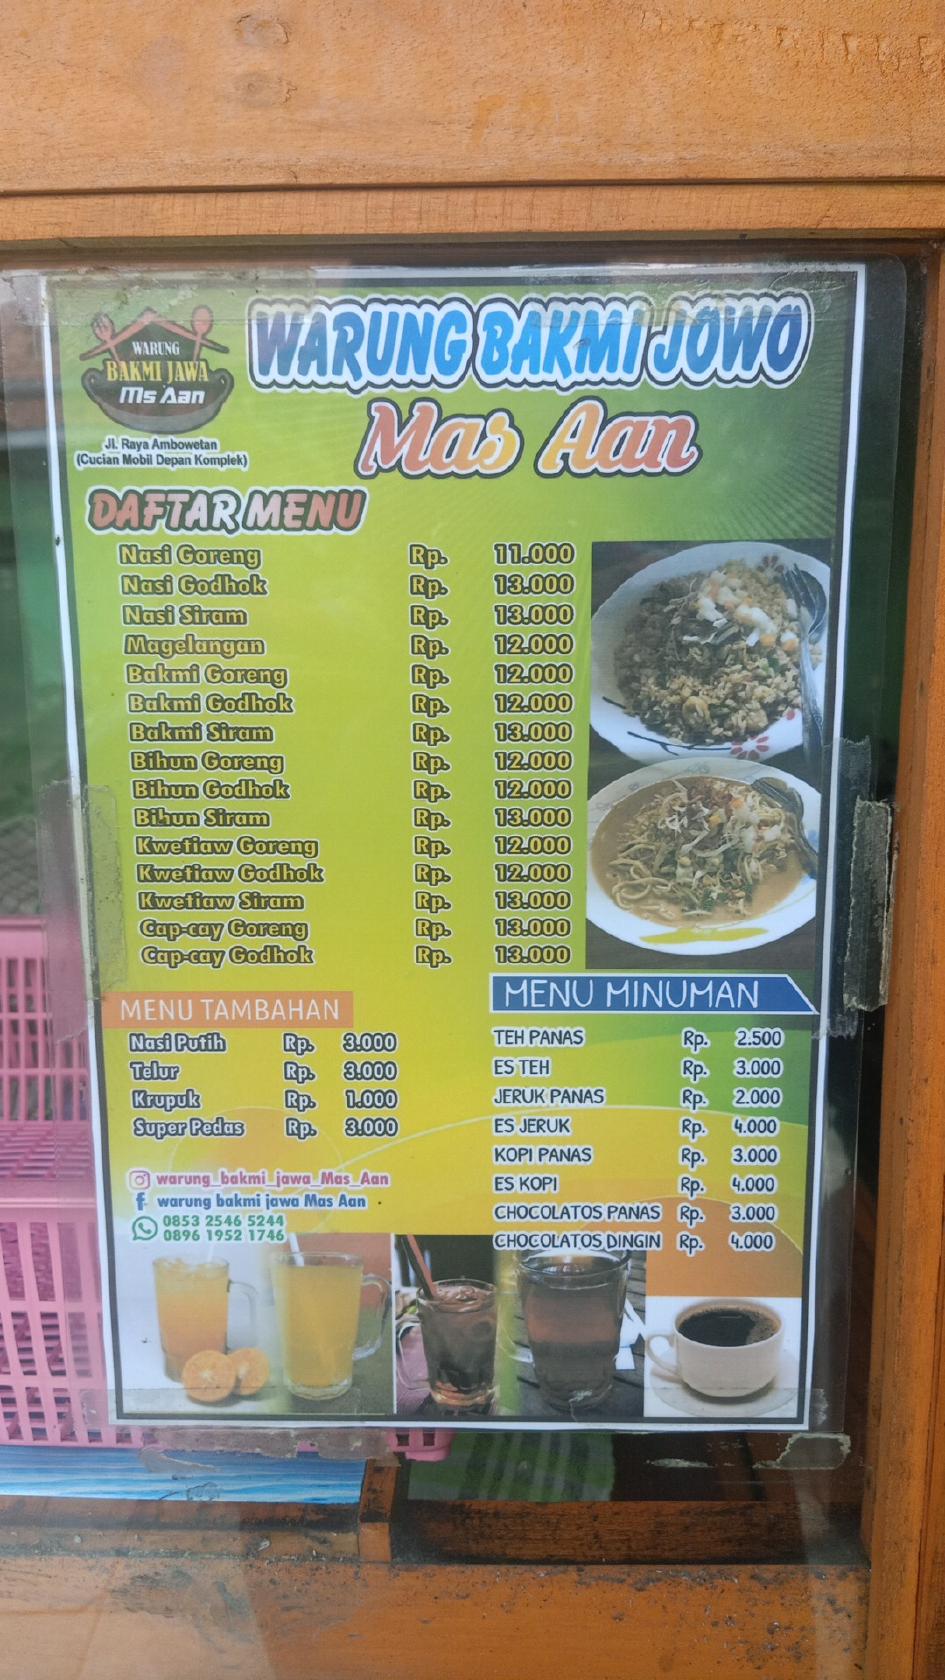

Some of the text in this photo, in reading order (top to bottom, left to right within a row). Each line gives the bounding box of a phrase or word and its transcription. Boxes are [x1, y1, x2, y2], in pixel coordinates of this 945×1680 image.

[132, 341, 180, 356] WARUNG
[250, 294, 810, 392] WARUNG BAKMI JOWO
[106, 361, 208, 382] BAKMI JAWA
[105, 439, 217, 452] Jl. Raya Ambowetan
[355, 396, 702, 479] Mas Aan
[76, 454, 248, 468] (Cucian Mobil Depan Komplek)
[88, 489, 367, 534] DAFTAR MENU
[119, 544, 574, 569] Nasi Goreng Rp. 11.000
[122, 574, 574, 599] Nasi Godhok Rp. 13.000
[123, 605, 573, 629] Nasi Siram Rp. 13.000
[124, 634, 573, 659] Magelangan Rp. 12.000
[127, 664, 573, 688] Bakmi Goreng Rp. 12.000
[129, 693, 572, 717] Bakmi Godhok Rp. 12.000
[130, 722, 572, 746] Bakmi Siram Rp. 13.000
[131, 751, 571, 774] Bihun Goreng Rp. 12.000
[133, 779, 571, 802] Bihun Godhok Rp. 12.000
[135, 808, 571, 830] Bihun Siram Rp. 13.000
[136, 836, 571, 858] Kwetiaw Goreng Rp. 12.000
[137, 864, 571, 886] Kwetiaw Godhok Rp. 12.000
[139, 892, 571, 913] Kwetiaw Siram Rp. 13.000
[140, 919, 571, 941] Cap-cay Goreng Rp. 13.000
[142, 946, 571, 968] Cap-cay Godhok Rp. 13.000
[505, 980, 759, 1008] MENU MINUMAN
[121, 999, 340, 1020] MENU TAMBAHAN
[130, 1033, 397, 1055] Nasi Putih Rp. 3.000
[494, 1030, 782, 1052] TEH PANAS Rp. 2.500
[130, 1061, 397, 1083] Telur Rp. 3.000
[494, 1060, 781, 1081] ES TEH Rp. 3.000
[132, 1090, 397, 1112] Krupuk Rp. 1.000
[494, 1090, 781, 1110] JERUK PANAS Rp. 2.000
[134, 1118, 398, 1139] Super Pedas Rp. 3.000
[494, 1119, 777, 1139] ES JERUK Rp. 4.000
[494, 1148, 777, 1169] KOPI PANAS Rp. 3.000
[156, 1172, 389, 1188] warung_bakmi_jawa_Mas_Aan
[494, 1177, 775, 1197] ES KOPI Rp. 4.000
[157, 1194, 366, 1210] warung bakmi jawa Mas Aan
[163, 1215, 284, 1227] 0853 2546 5244
[494, 1206, 775, 1226] CHOCOLATOS PANAS Rp. 3.000
[164, 1230, 284, 1241] 0896 1952 1746
[494, 1235, 773, 1255] CHOCOLATOS DINGIN Rp. 4.000
